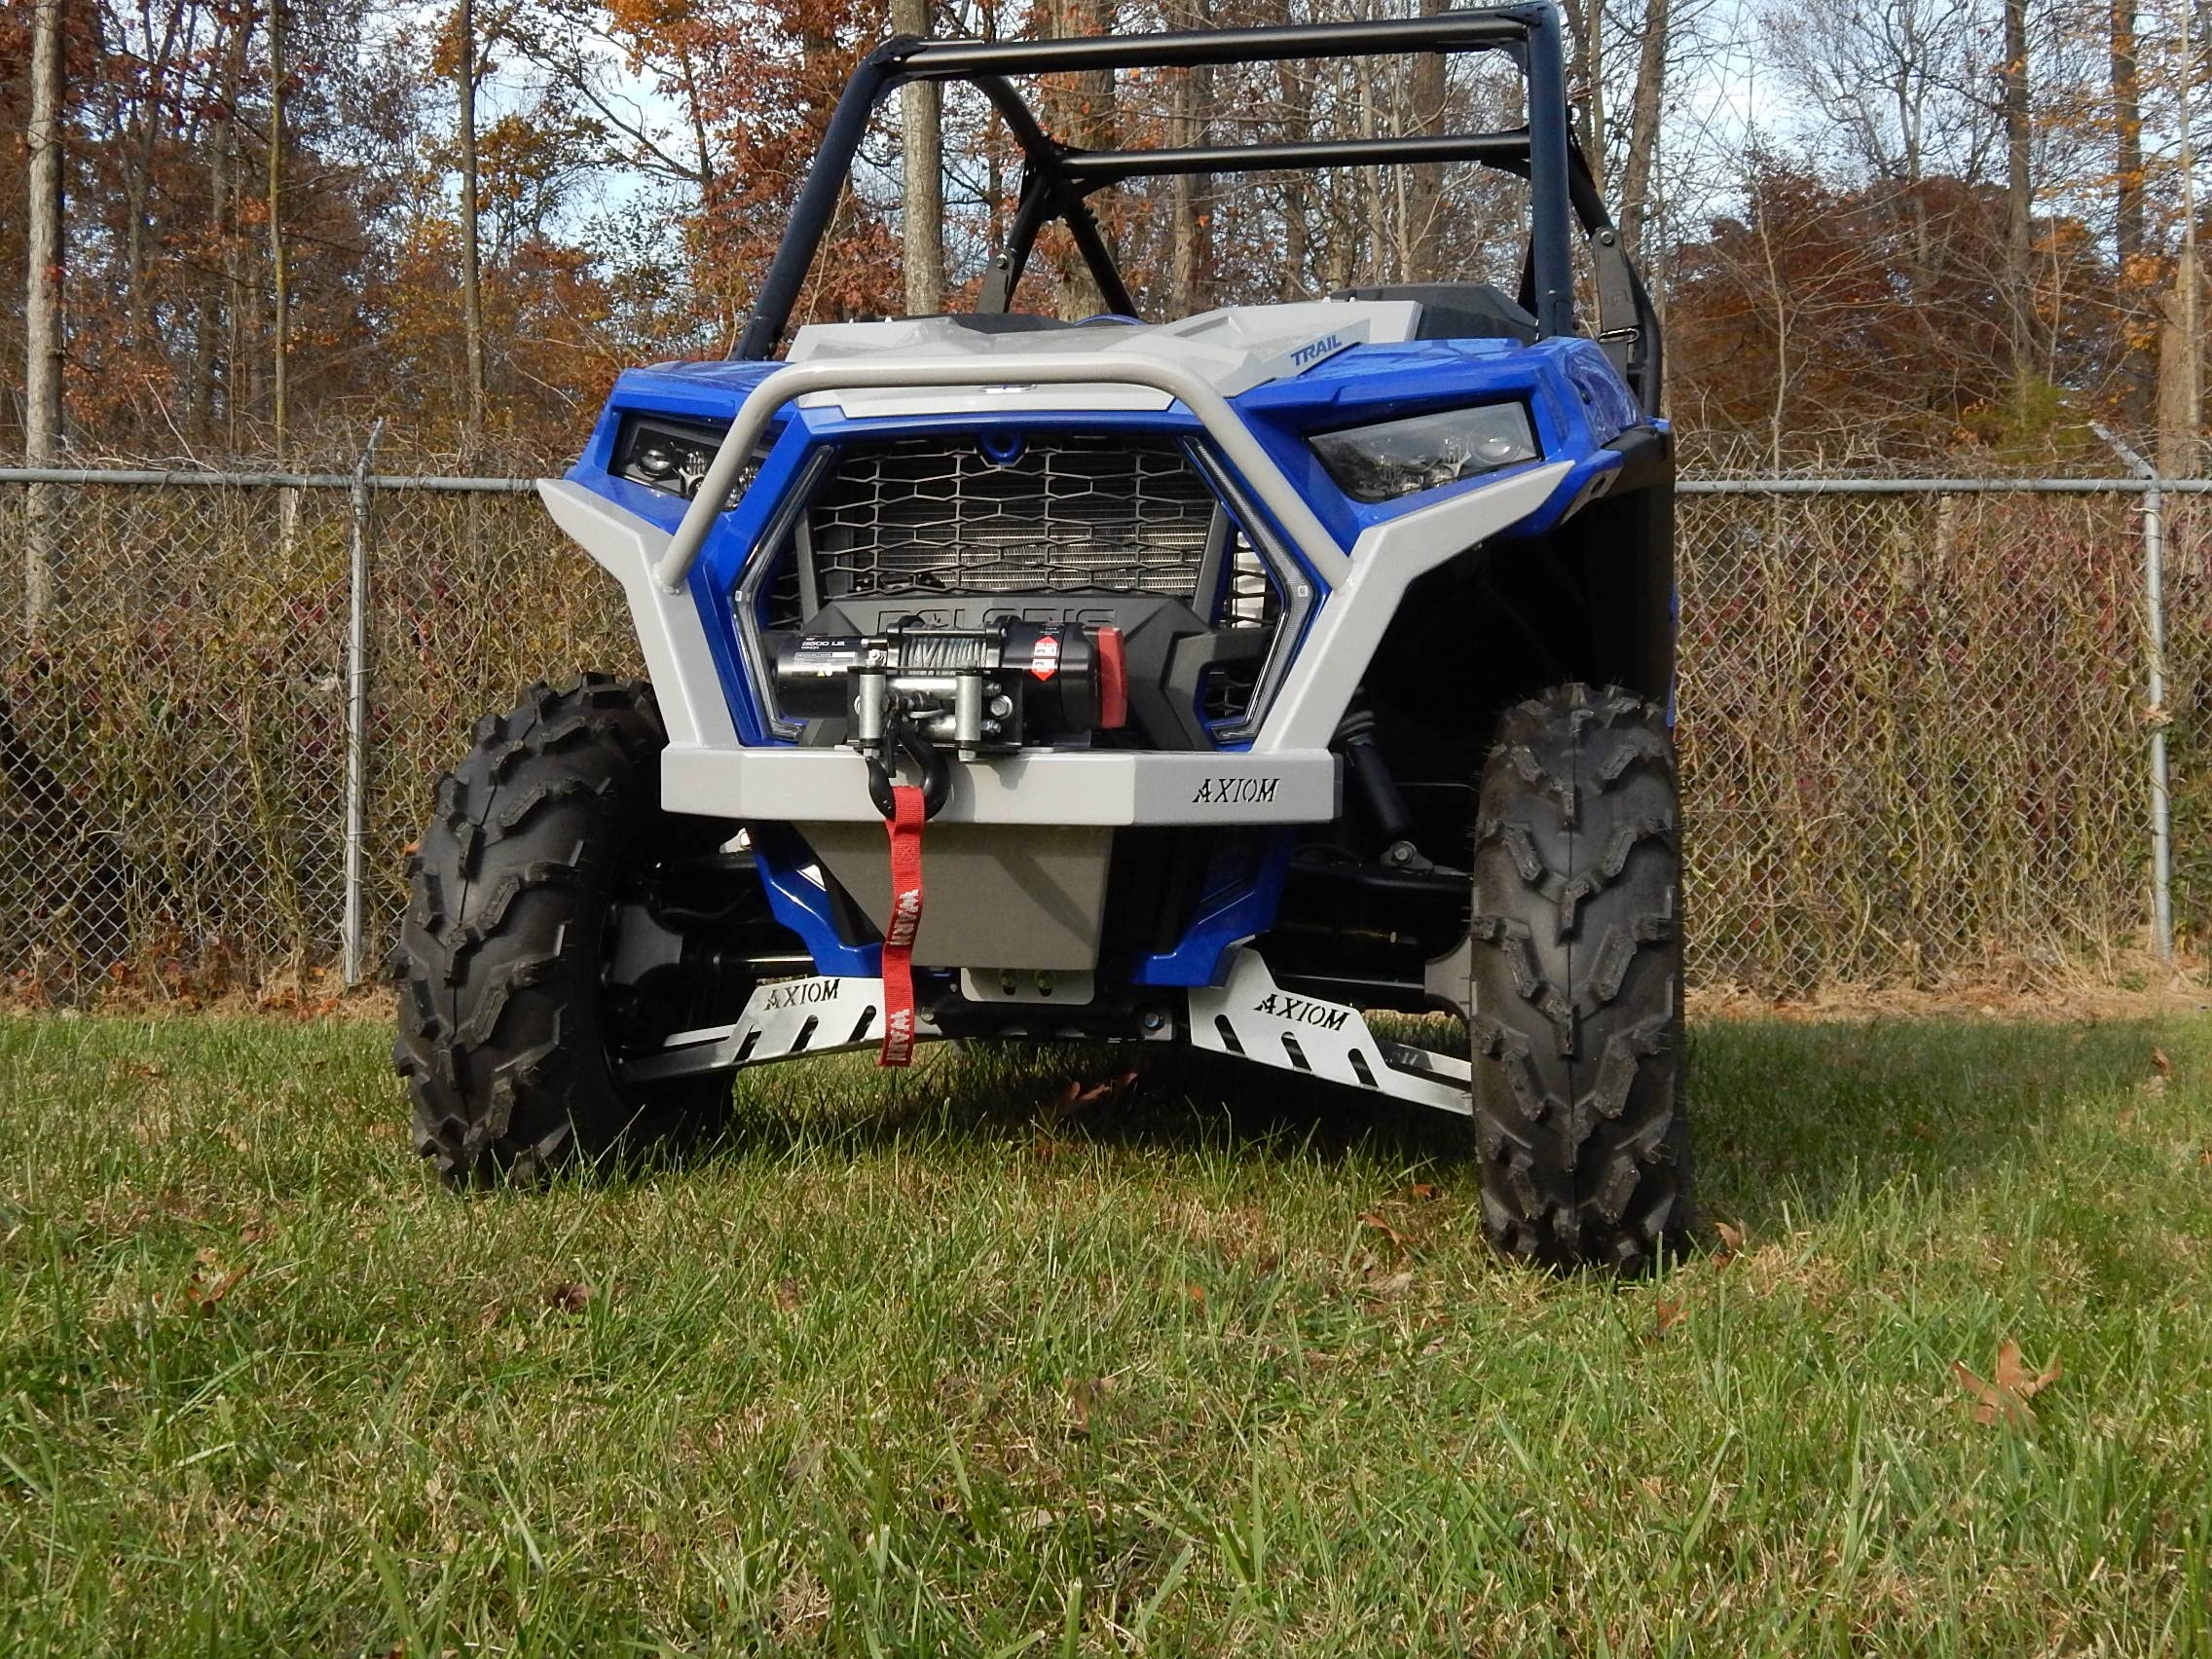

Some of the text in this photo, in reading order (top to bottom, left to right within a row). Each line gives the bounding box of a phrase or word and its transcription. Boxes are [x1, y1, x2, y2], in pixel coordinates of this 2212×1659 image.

[1290, 334, 1343, 367] TRAIL
[1192, 778, 1280, 803] AXIOM
[887, 888, 920, 946] WARN
[763, 977, 841, 1012] AXIOM
[1253, 993, 1350, 1031] AXIOM
[886, 1009, 910, 1061] WARN
